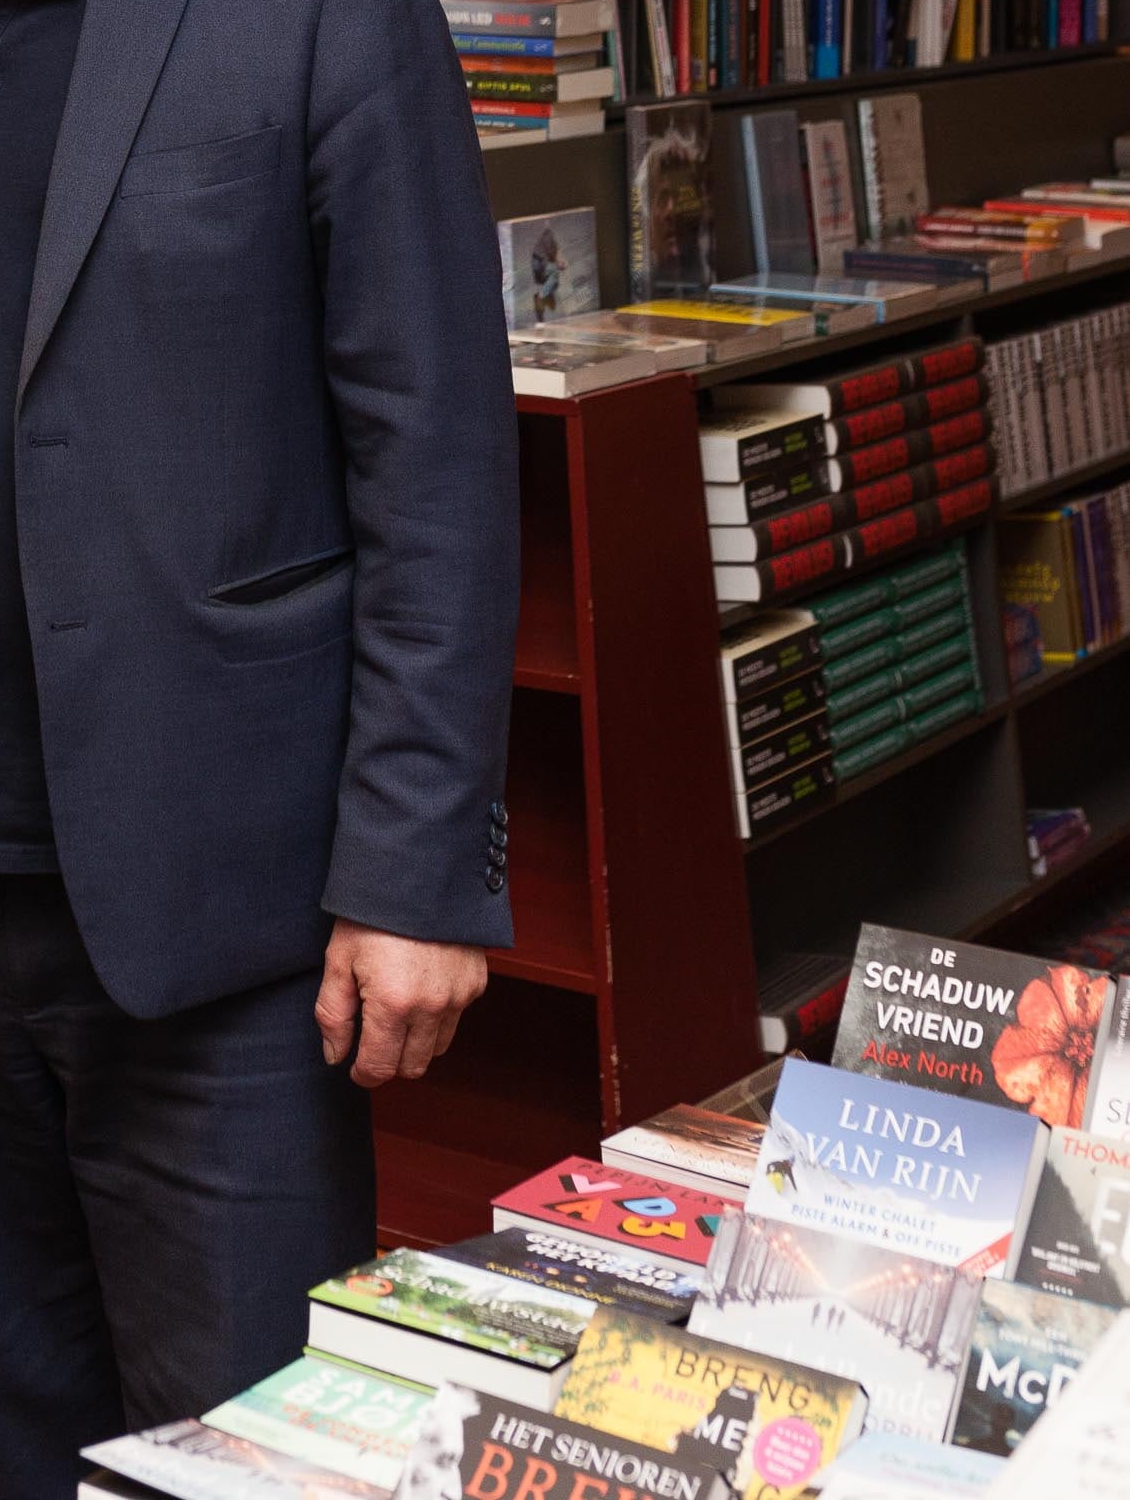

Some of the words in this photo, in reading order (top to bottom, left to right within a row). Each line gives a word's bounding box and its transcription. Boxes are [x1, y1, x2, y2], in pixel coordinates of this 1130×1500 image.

[930, 947, 957, 968] DE
[862, 960, 1015, 1016] SCHADUW
[876, 1001, 984, 1050] VRIEND
[861, 1038, 911, 1070] Alex
[917, 1051, 984, 1087] North
[838, 1097, 967, 1158] LINDA
[804, 1132, 885, 1180] VAN
[890, 1153, 983, 1204] RIJN
[791, 1203, 828, 1224] PISTE
[831, 1214, 879, 1236] ALARM
[895, 1230, 920, 1248] OFF
[925, 1238, 963, 1258] PISTE
[823, 1193, 876, 1217] WINTER
[881, 1207, 936, 1233] CHALET
[652, 1383, 708, 1408] PARIS
[674, 1350, 812, 1410] BRENG
[490, 1412, 554, 1454] HET
[550, 1432, 702, 1500] SENIOREN
[692, 1415, 749, 1450] ME
